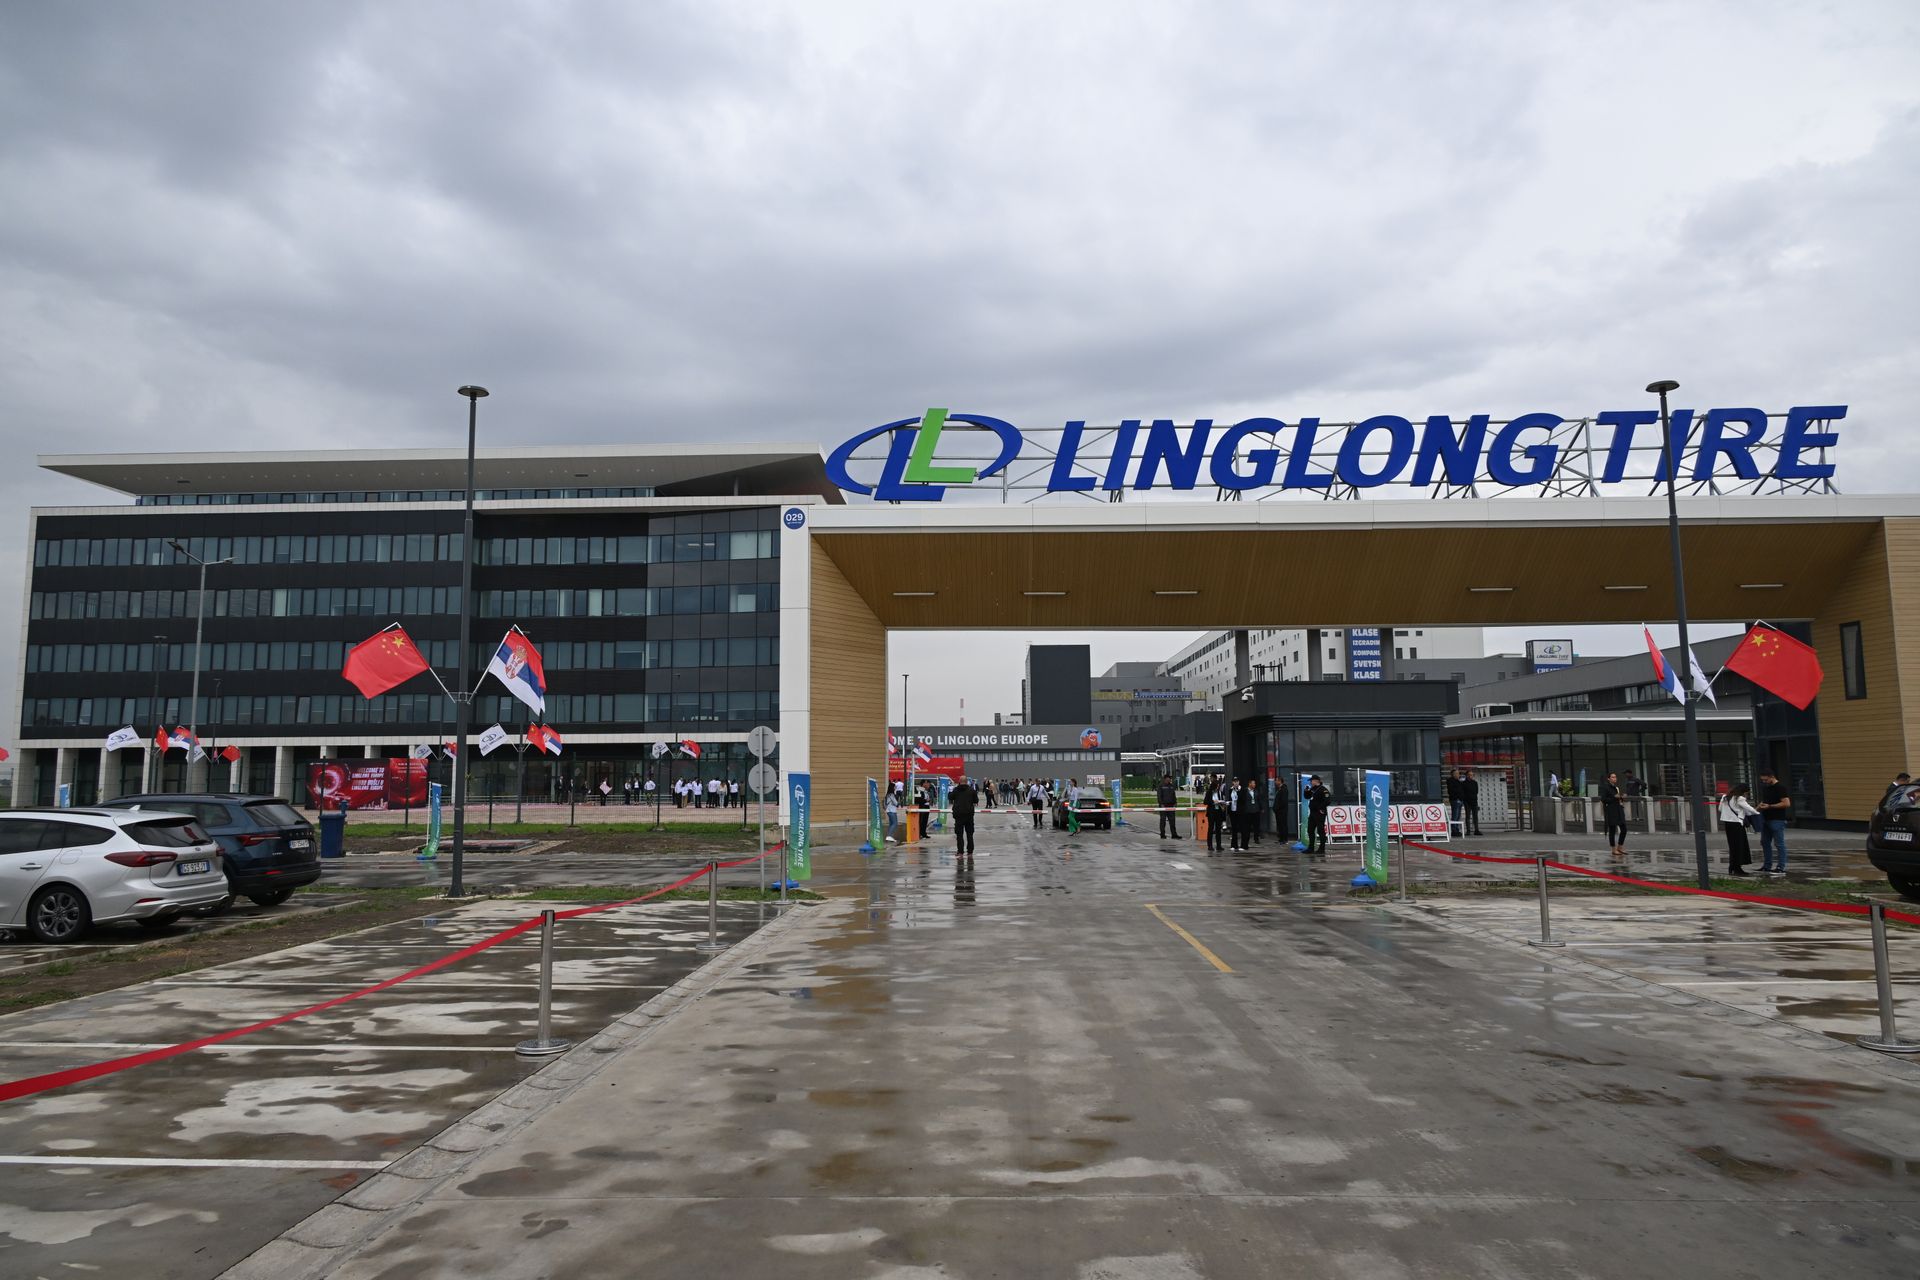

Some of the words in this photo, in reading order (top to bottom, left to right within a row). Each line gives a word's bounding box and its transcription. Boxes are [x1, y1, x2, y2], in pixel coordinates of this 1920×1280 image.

[1047, 413, 1564, 491] LINGLONG
[1596, 405, 1848, 483] TIRE
[1354, 671, 1380, 679] KLASE
[917, 735, 933, 745] TO
[938, 735, 998, 745] LINGLONG
[1001, 734, 1048, 745] EUROPE
